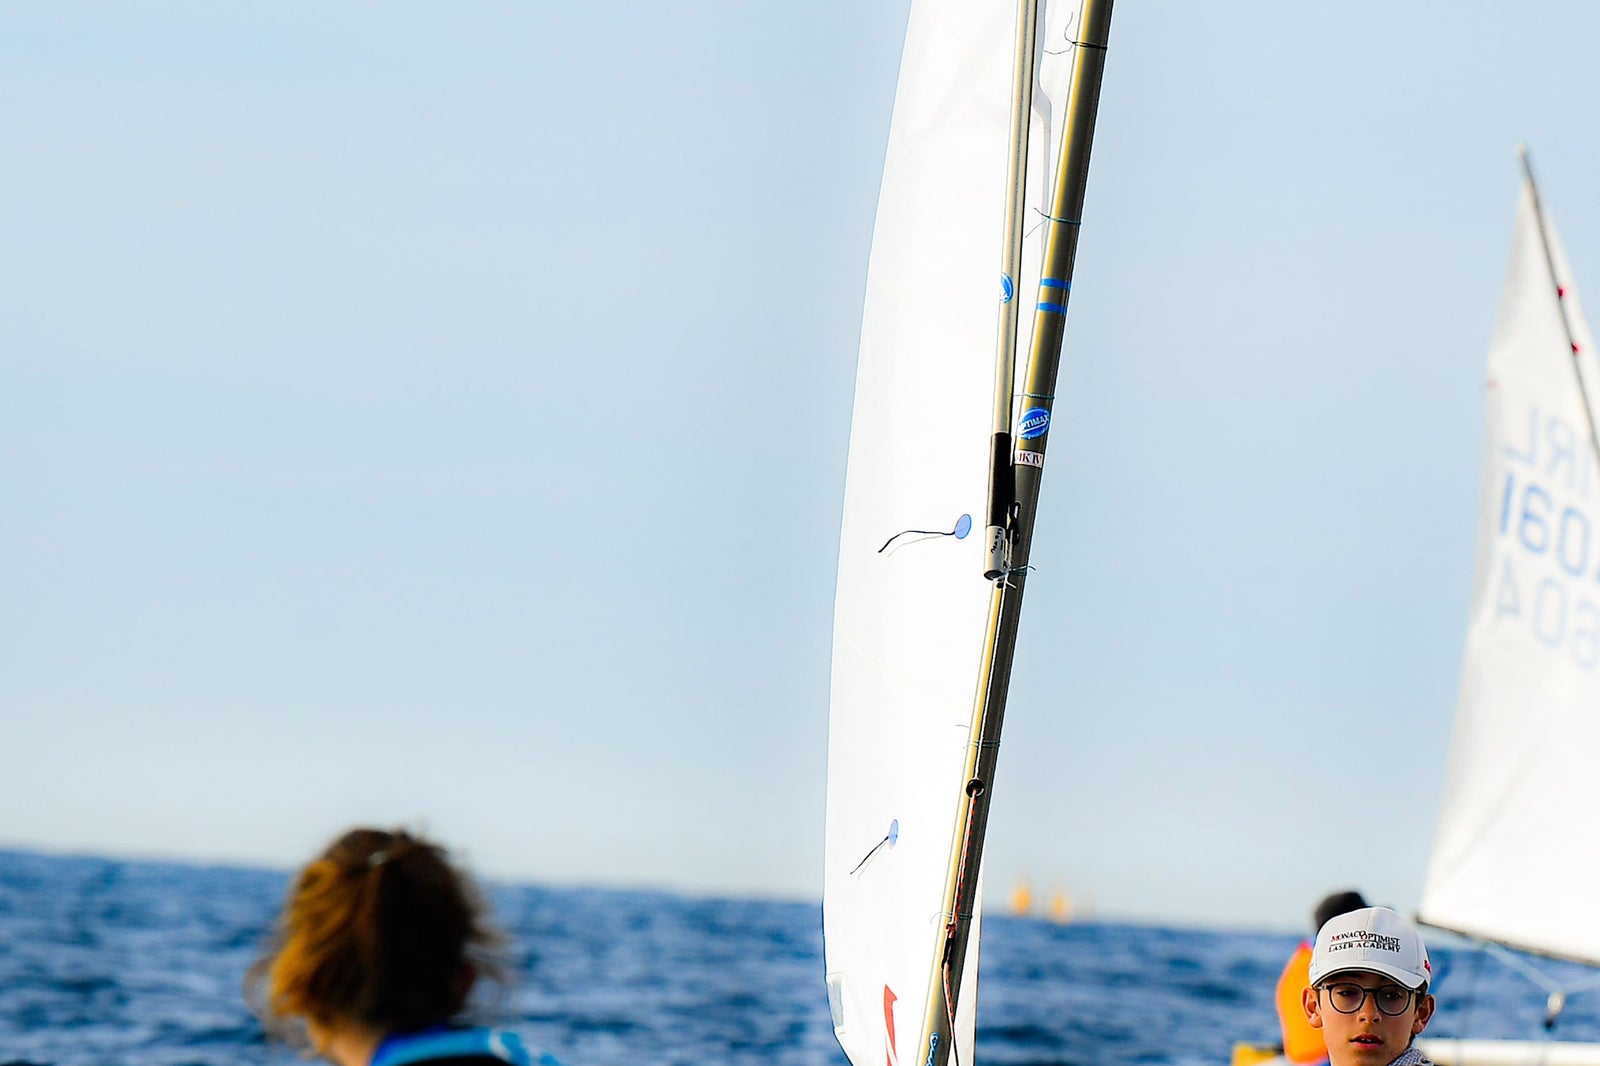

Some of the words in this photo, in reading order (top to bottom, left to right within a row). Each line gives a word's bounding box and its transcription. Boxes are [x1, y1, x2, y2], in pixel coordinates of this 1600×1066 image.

[1331, 930, 1366, 942] MONACO
[1360, 933, 1400, 946] OPTIMIST
[1328, 942, 1353, 952] LASER
[1356, 942, 1400, 952] ACADEMY
